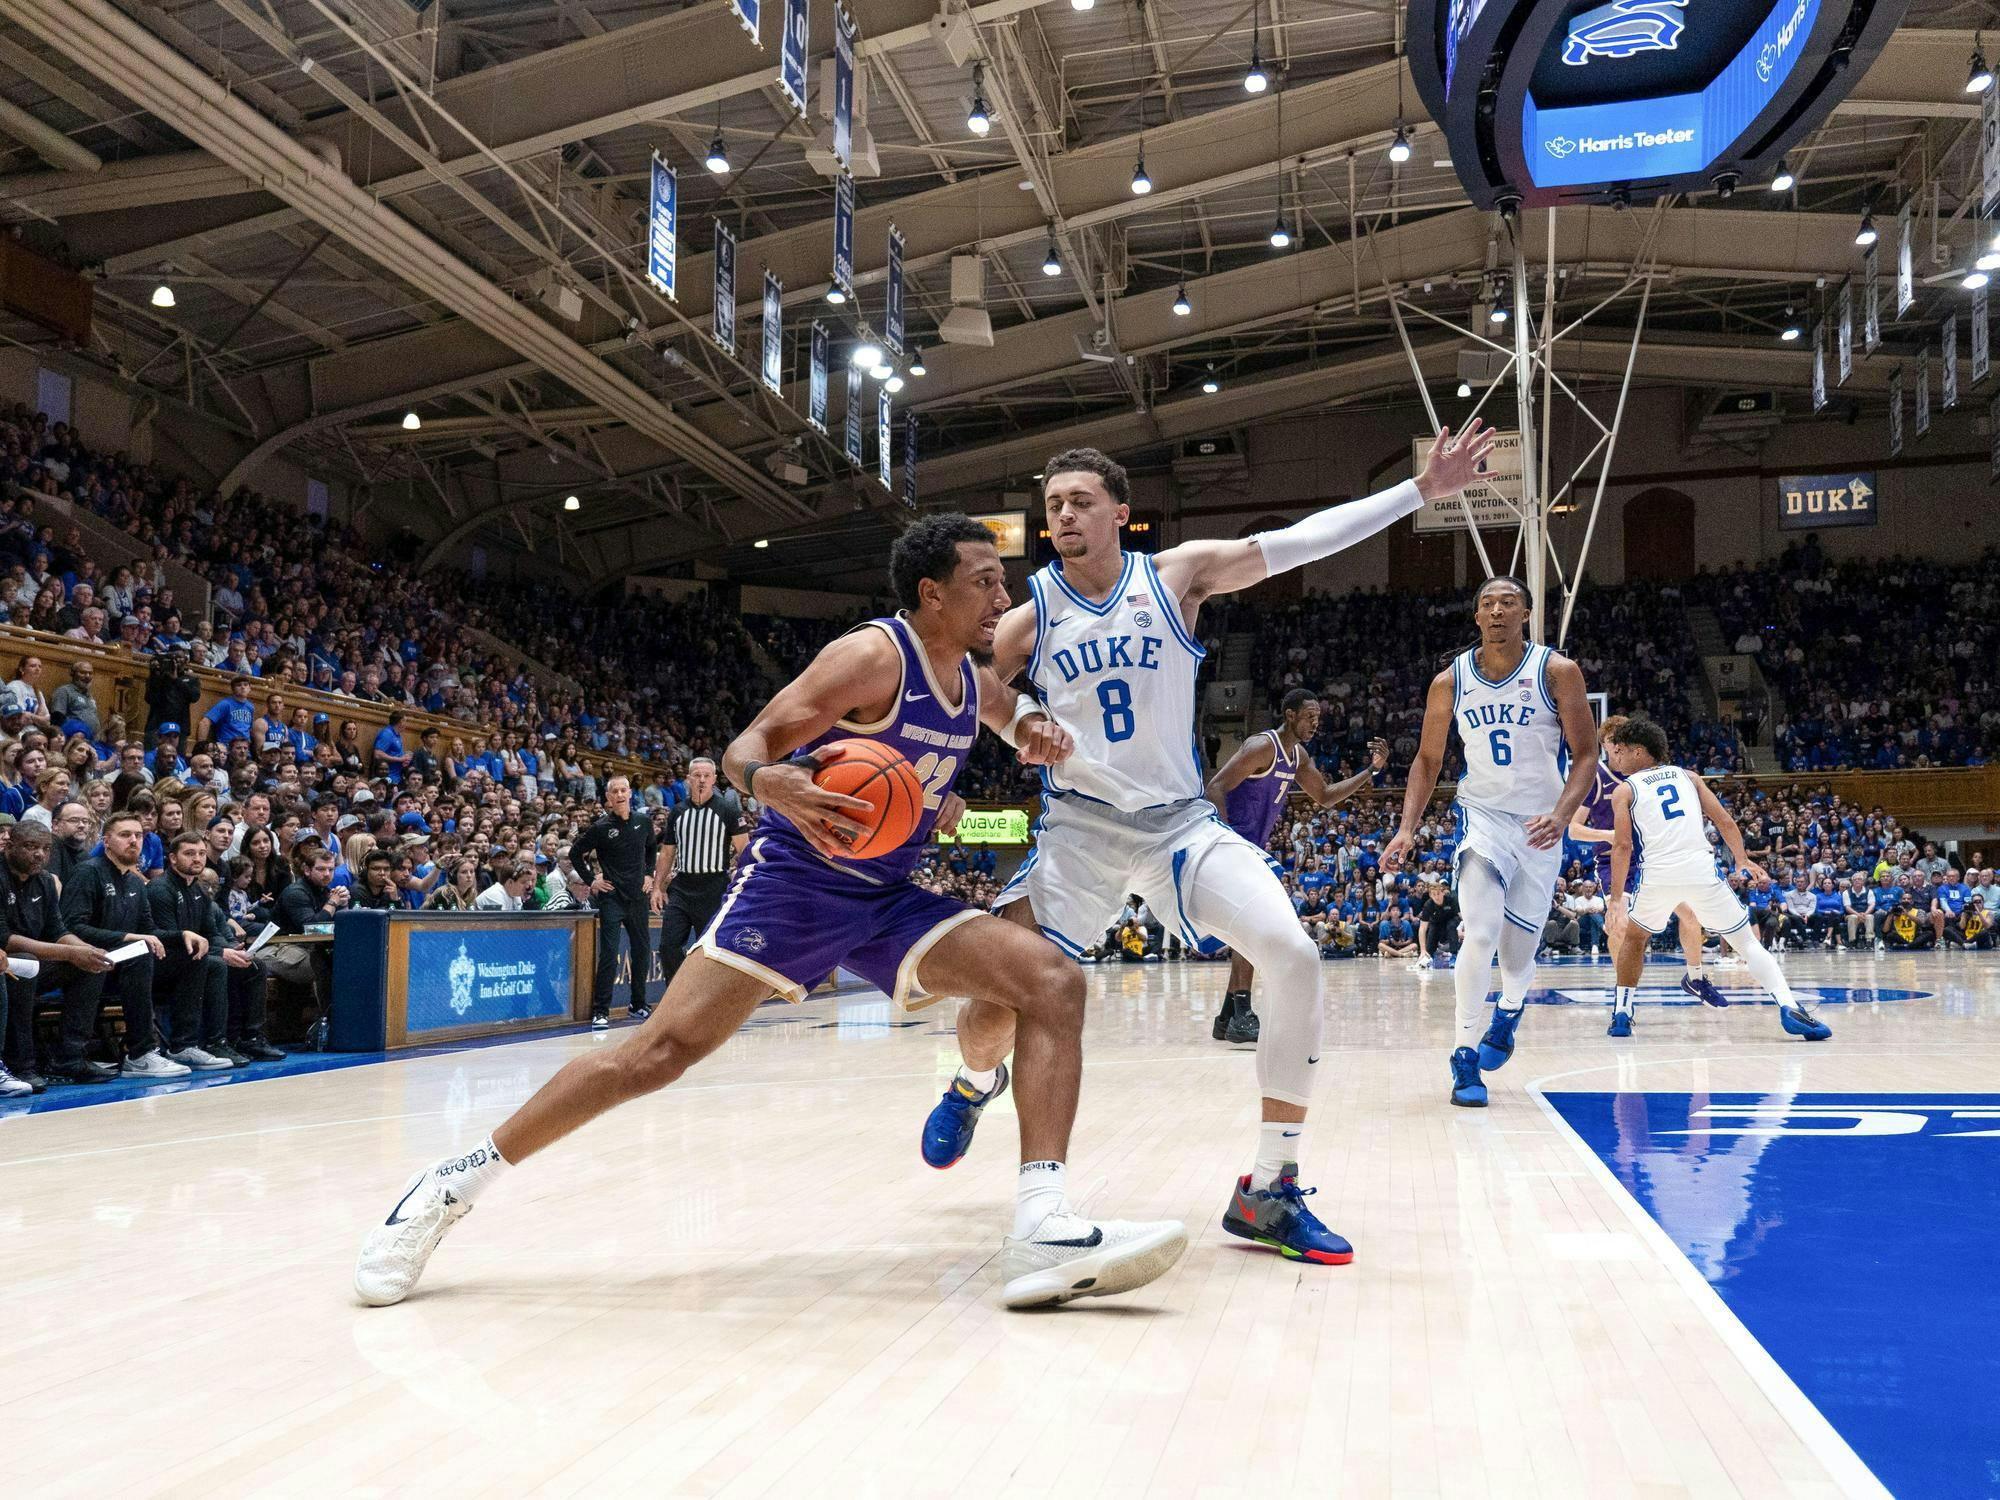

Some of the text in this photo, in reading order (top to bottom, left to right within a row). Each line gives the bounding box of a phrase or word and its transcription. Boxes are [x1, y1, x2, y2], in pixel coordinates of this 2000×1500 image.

[1579, 128, 1695, 153] Harris Teeter
[1464, 488, 1488, 498] MOST
[1786, 488, 1868, 515] DUKE
[1052, 635, 1163, 684] DUKE
[1096, 678, 1135, 743] 8
[1463, 703, 1536, 730] DUKE
[900, 722, 949, 747] WESTERN
[1488, 729, 1512, 766] 6
[1642, 771, 1678, 786] BOOZER
[1657, 784, 1685, 820] 2
[478, 961, 536, 980] Washington Duke
[480, 984, 492, 998] Inn
[493, 982, 500, 997] &
[500, 981, 516, 996] Golf
